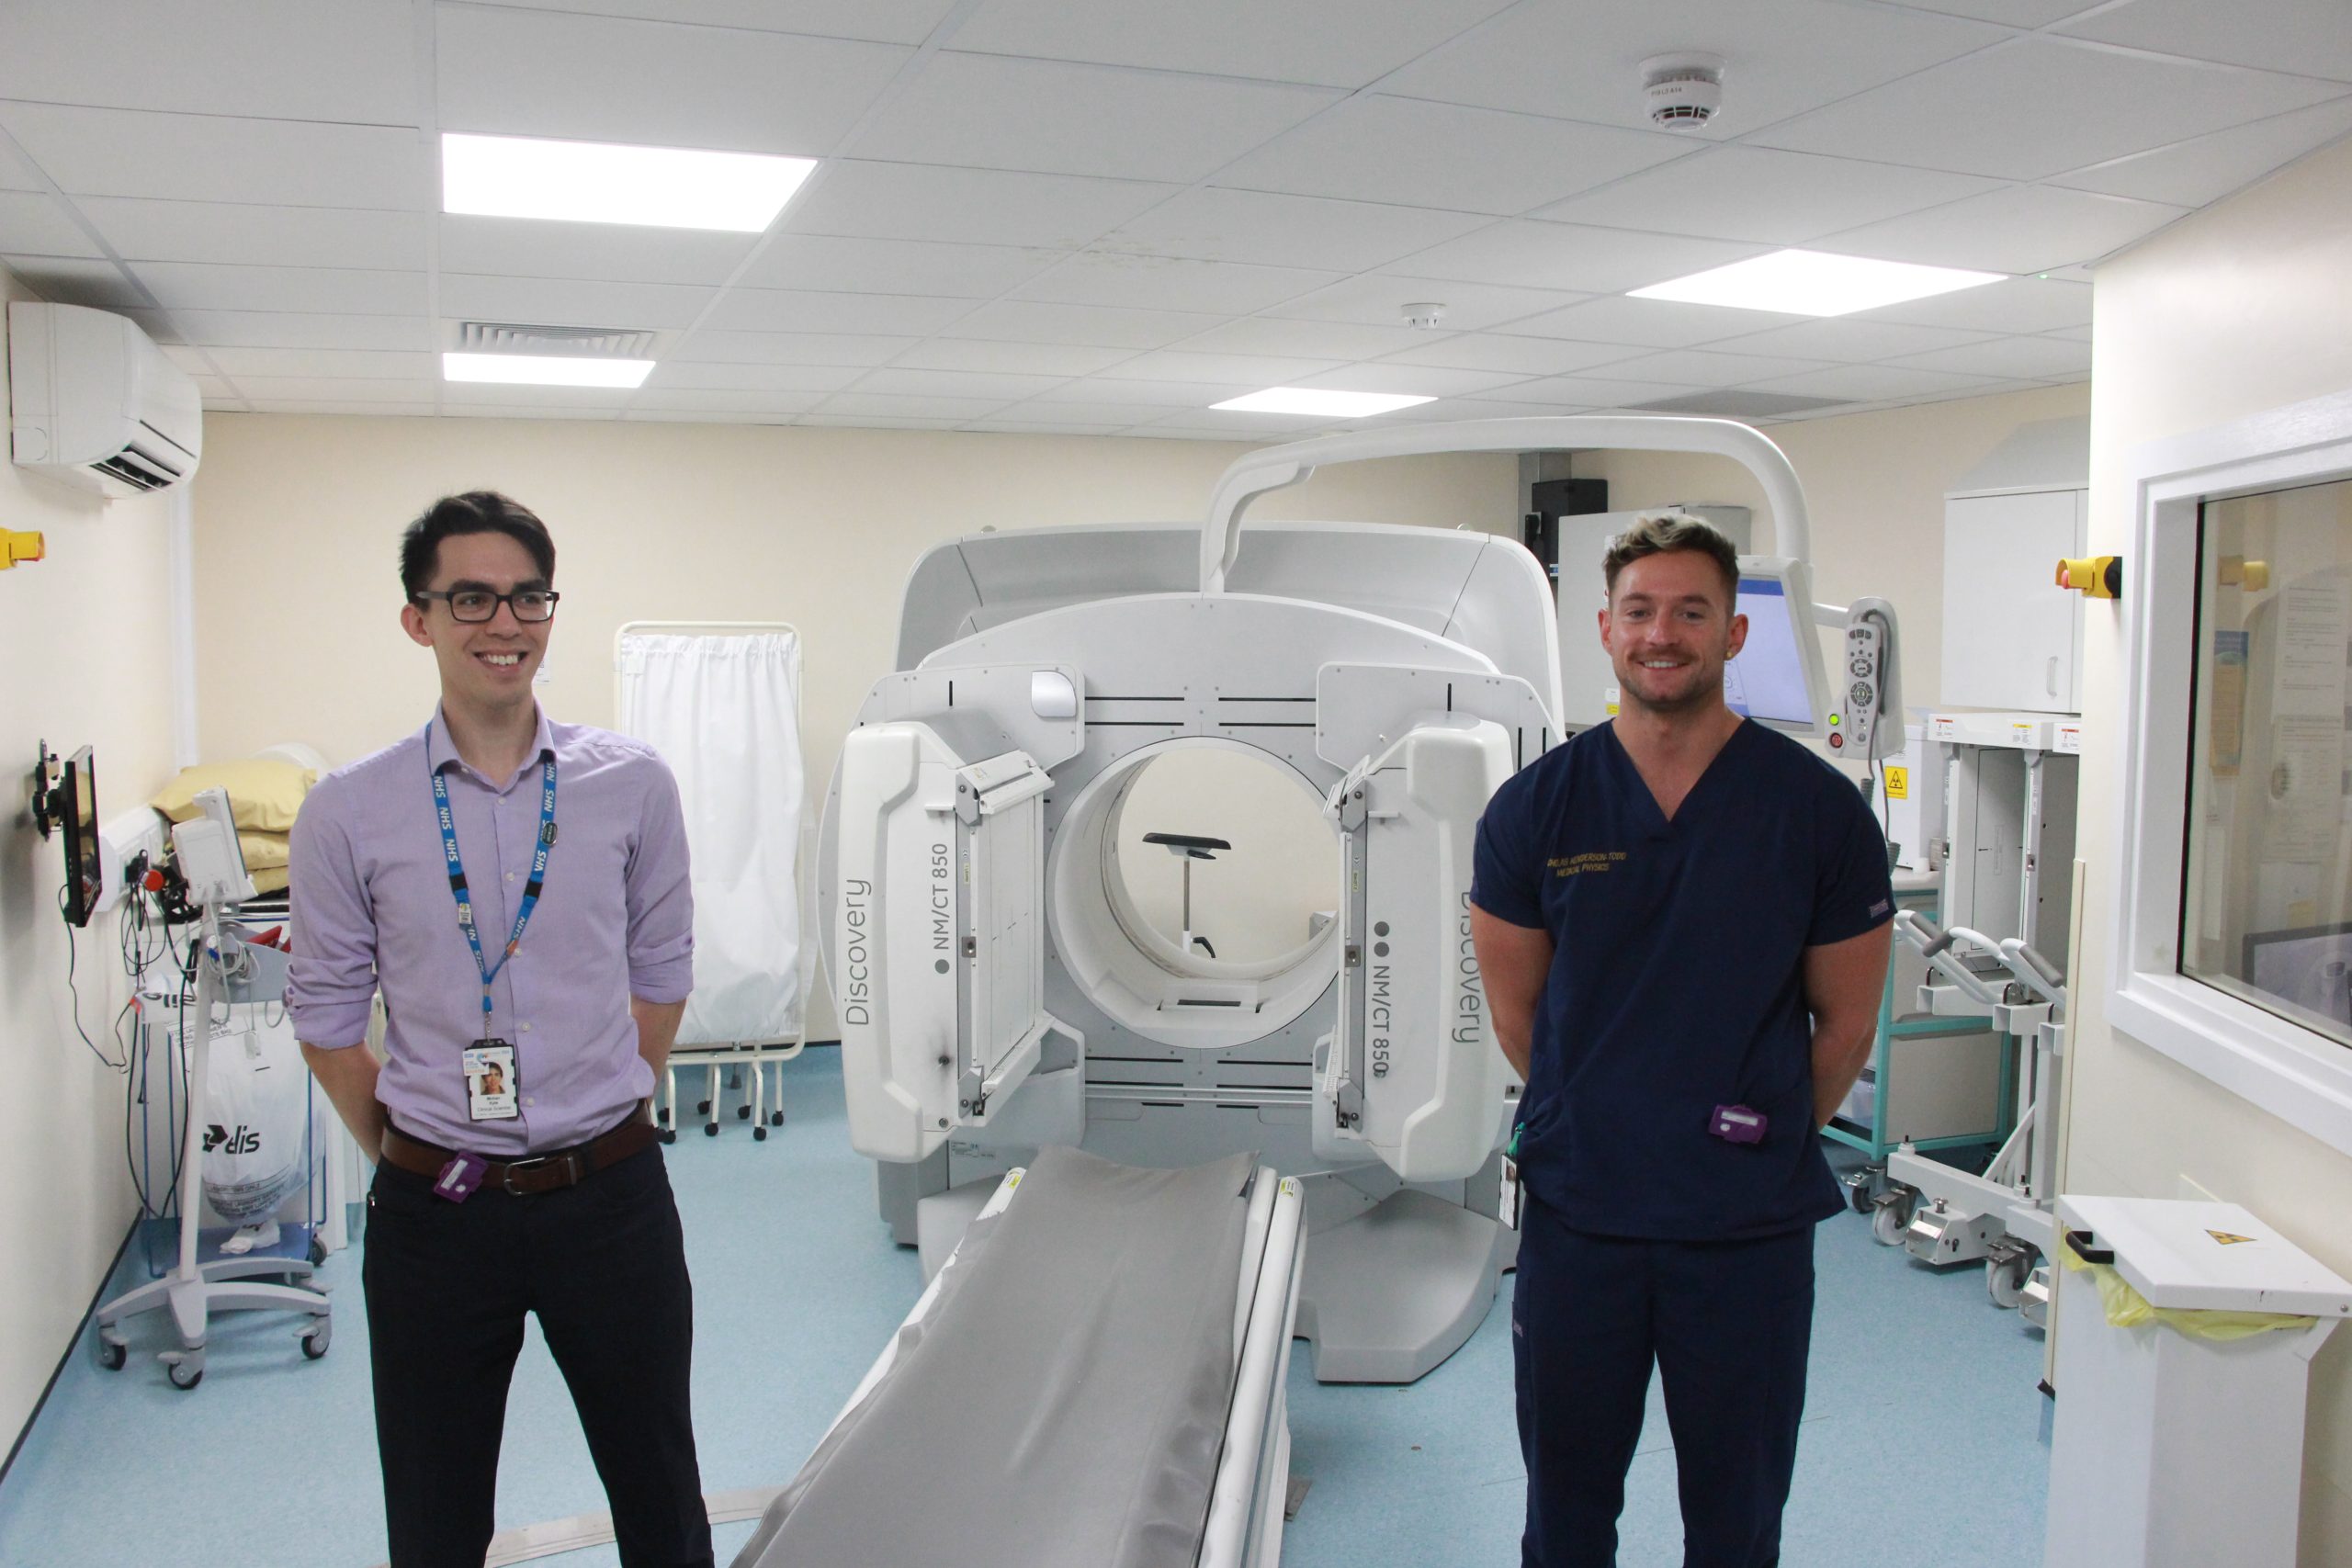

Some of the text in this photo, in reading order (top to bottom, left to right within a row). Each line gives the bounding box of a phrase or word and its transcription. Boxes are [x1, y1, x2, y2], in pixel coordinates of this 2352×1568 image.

[434, 776, 446, 798] NHS
[543, 788, 555, 813] NHS
[439, 807, 452, 830] NHS
[445, 839, 458, 863] NHS
[931, 843, 950, 950] NM/CT 850
[844, 879, 872, 1025] Discovery
[1372, 965, 1392, 1073] NM/CT 850
